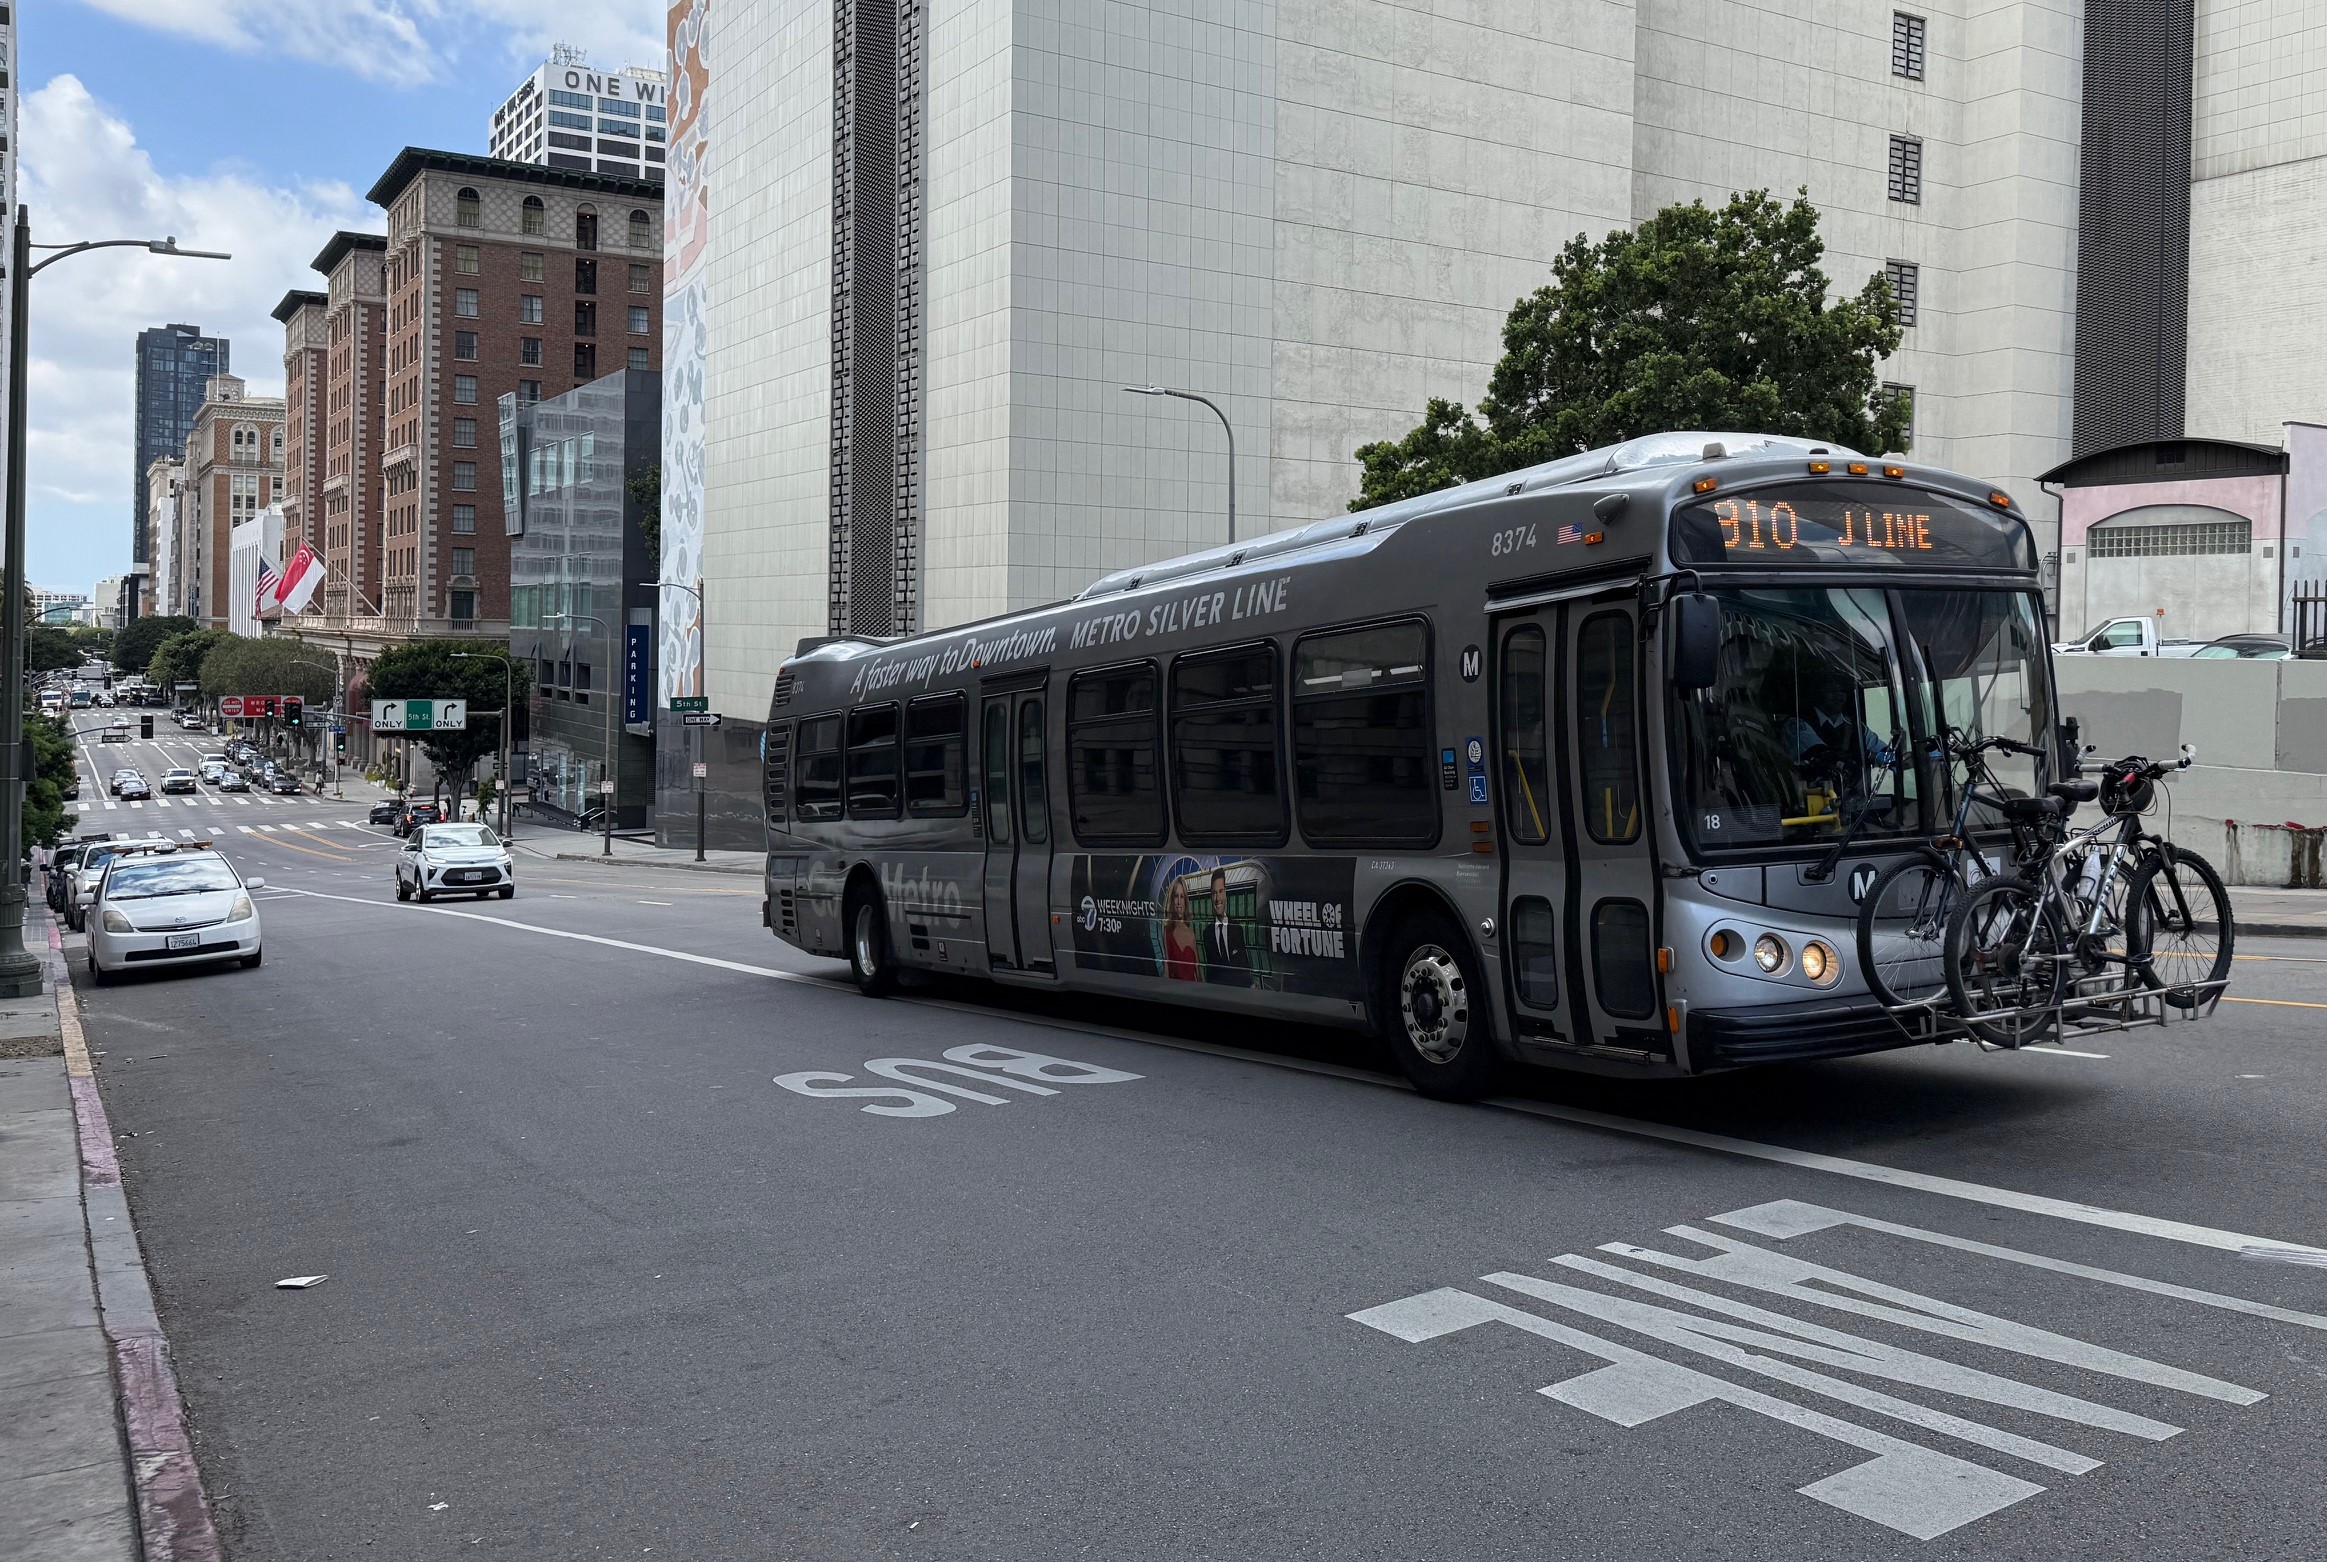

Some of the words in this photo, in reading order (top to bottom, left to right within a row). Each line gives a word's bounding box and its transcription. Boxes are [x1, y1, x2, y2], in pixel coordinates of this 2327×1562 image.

[565, 71, 620, 96] ONE
[635, 82, 665, 104] WI
[1491, 523, 1537, 556] 8374
[1714, 500, 1798, 549] 910
[1838, 511, 1854, 546] J
[1866, 512, 1933, 549] LINE
[850, 663, 867, 694] A
[859, 657, 906, 702] faster
[905, 653, 940, 689] way
[938, 645, 958, 676] to
[1069, 609, 1141, 650] METRO
[1146, 591, 1226, 636] SILVER
[1232, 576, 1292, 621] LINE
[1463, 651, 1479, 677] M
[436, 720, 463, 728] ONLY
[1704, 814, 1721, 829] 18
[881, 862, 962, 929] Metro
[1854, 870, 1876, 899] M
[1097, 899, 1156, 917] WEEKNIGHTS
[1269, 900, 1321, 927] WHEEL
[1270, 927, 1345, 958] FORTUNE
[773, 1043, 1146, 1118] BUS
[1343, 1199, 2327, 1541] LANE
